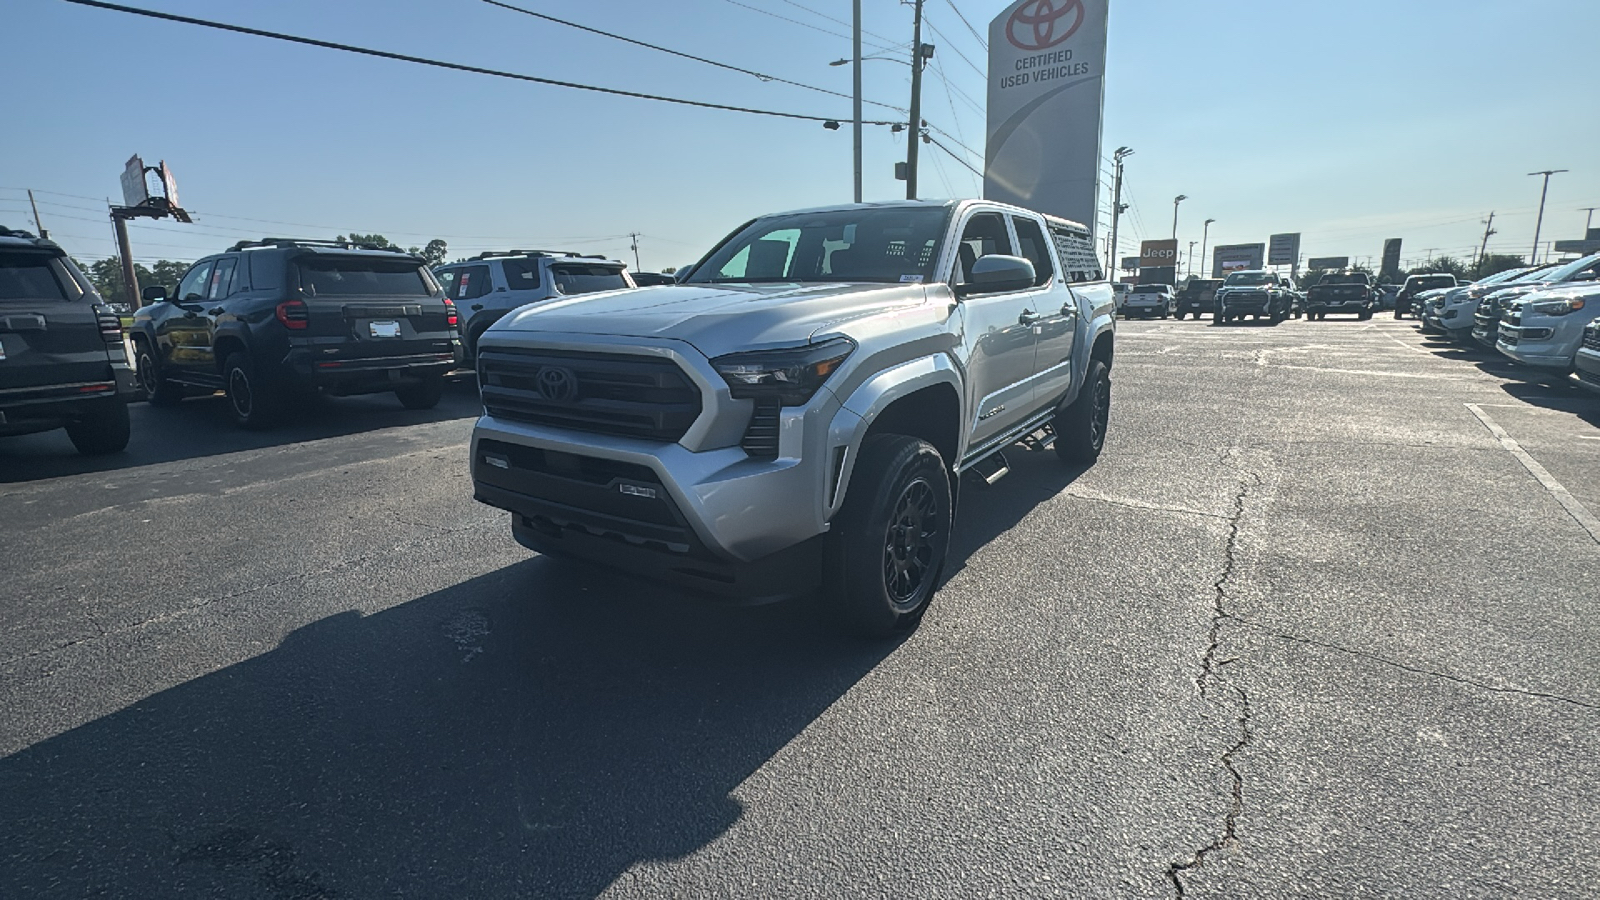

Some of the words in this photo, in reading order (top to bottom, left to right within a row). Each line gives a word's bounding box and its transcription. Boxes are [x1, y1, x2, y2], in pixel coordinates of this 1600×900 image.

[1015, 49, 1073, 71] CERTIFIED
[1001, 73, 1029, 89] USED
[1032, 62, 1089, 83] VEHICLES
[1142, 248, 1174, 259] Jeep
